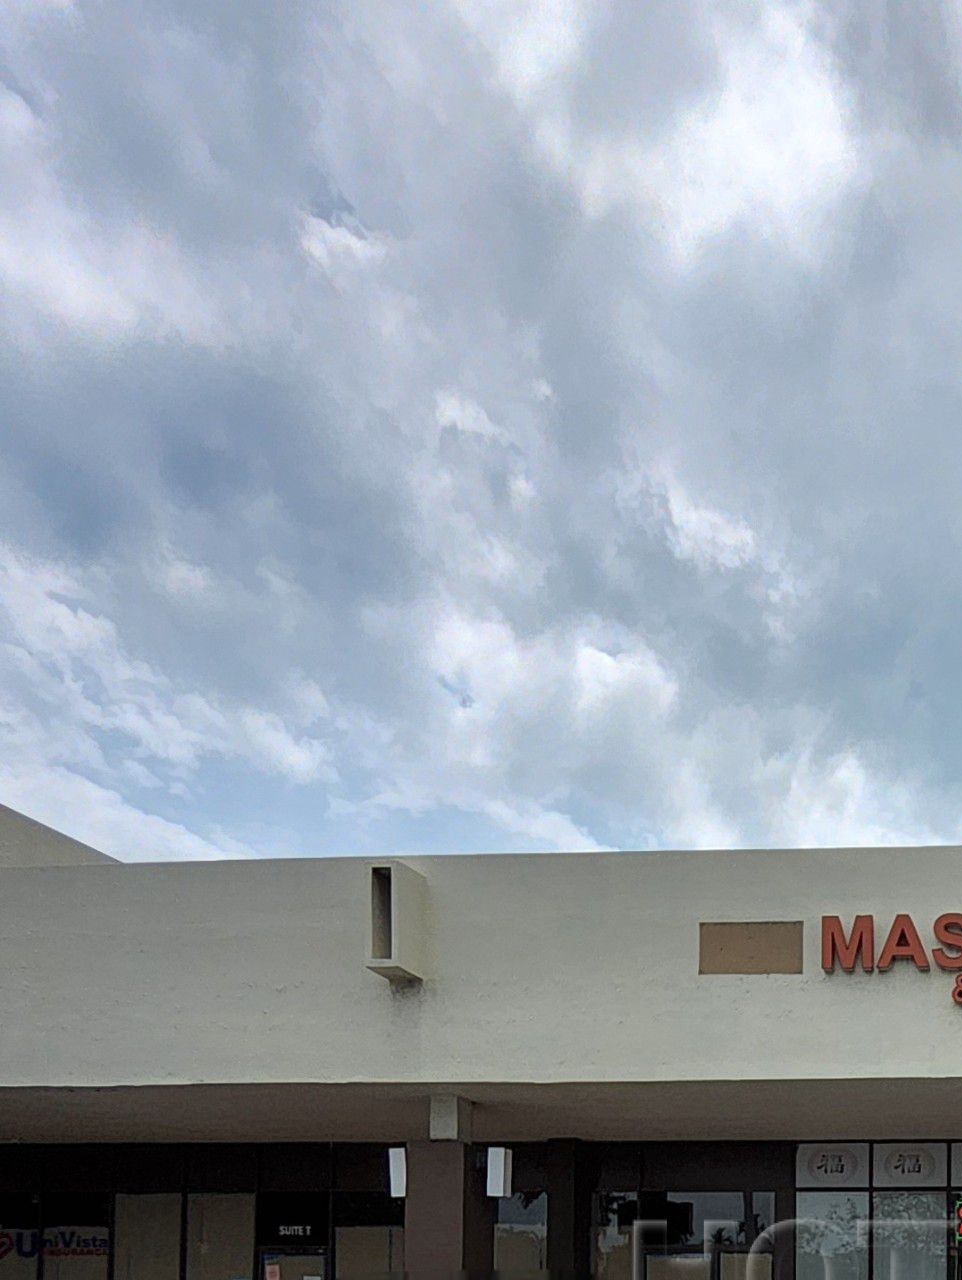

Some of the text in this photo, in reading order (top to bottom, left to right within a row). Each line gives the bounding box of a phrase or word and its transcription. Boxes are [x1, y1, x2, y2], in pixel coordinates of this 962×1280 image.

[816, 1152, 845, 1175] 福
[893, 1152, 922, 1175] 福
[278, 1224, 304, 1236] SUITE
[16, 1231, 109, 1257] UniVista
